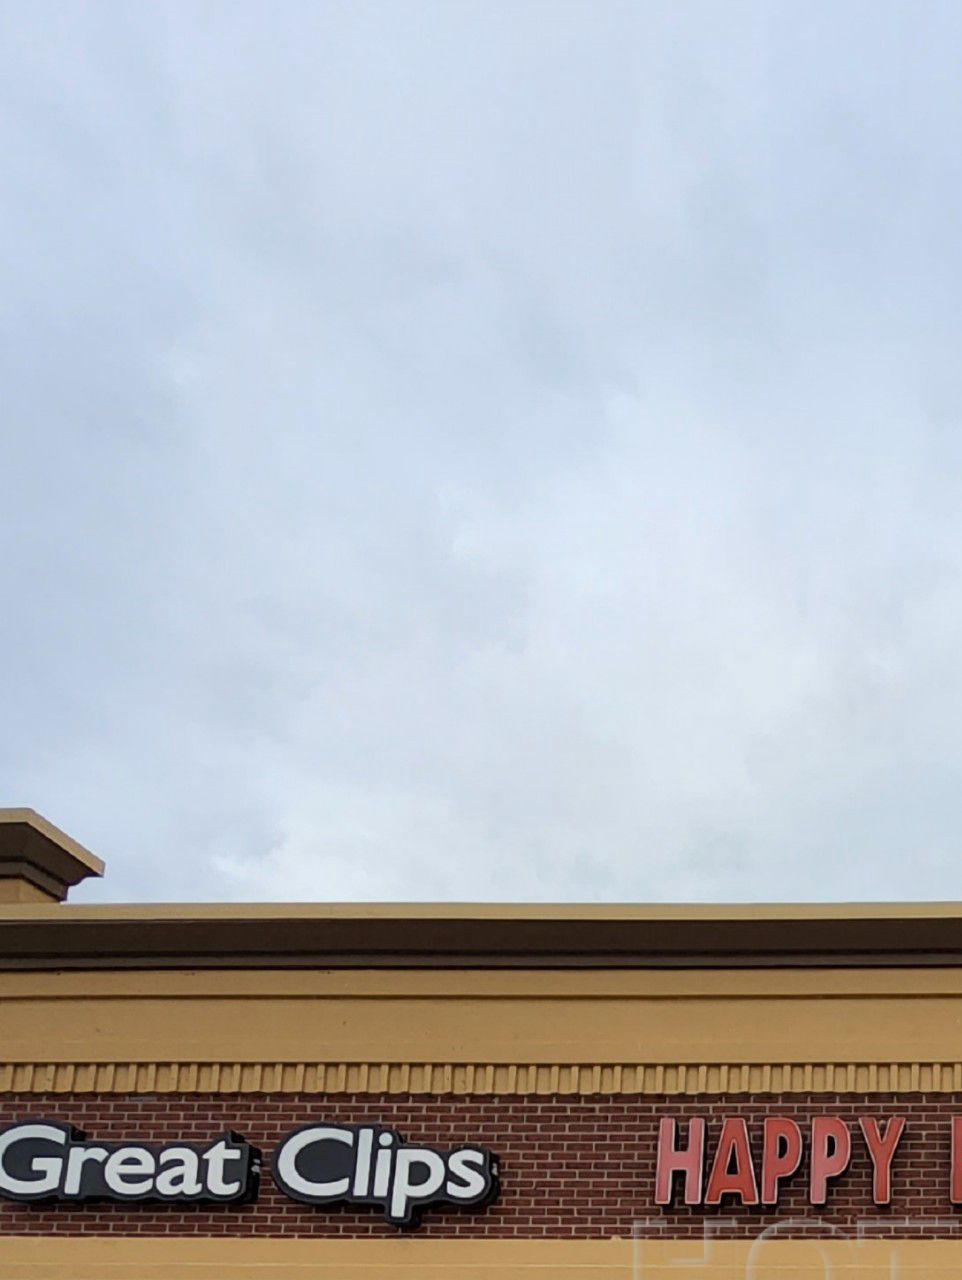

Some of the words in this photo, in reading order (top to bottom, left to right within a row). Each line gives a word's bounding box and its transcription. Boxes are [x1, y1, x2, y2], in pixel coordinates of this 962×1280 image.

[0, 1124, 243, 1196] Great
[278, 1127, 487, 1218] Clips
[655, 1117, 906, 1205] HAPPY
